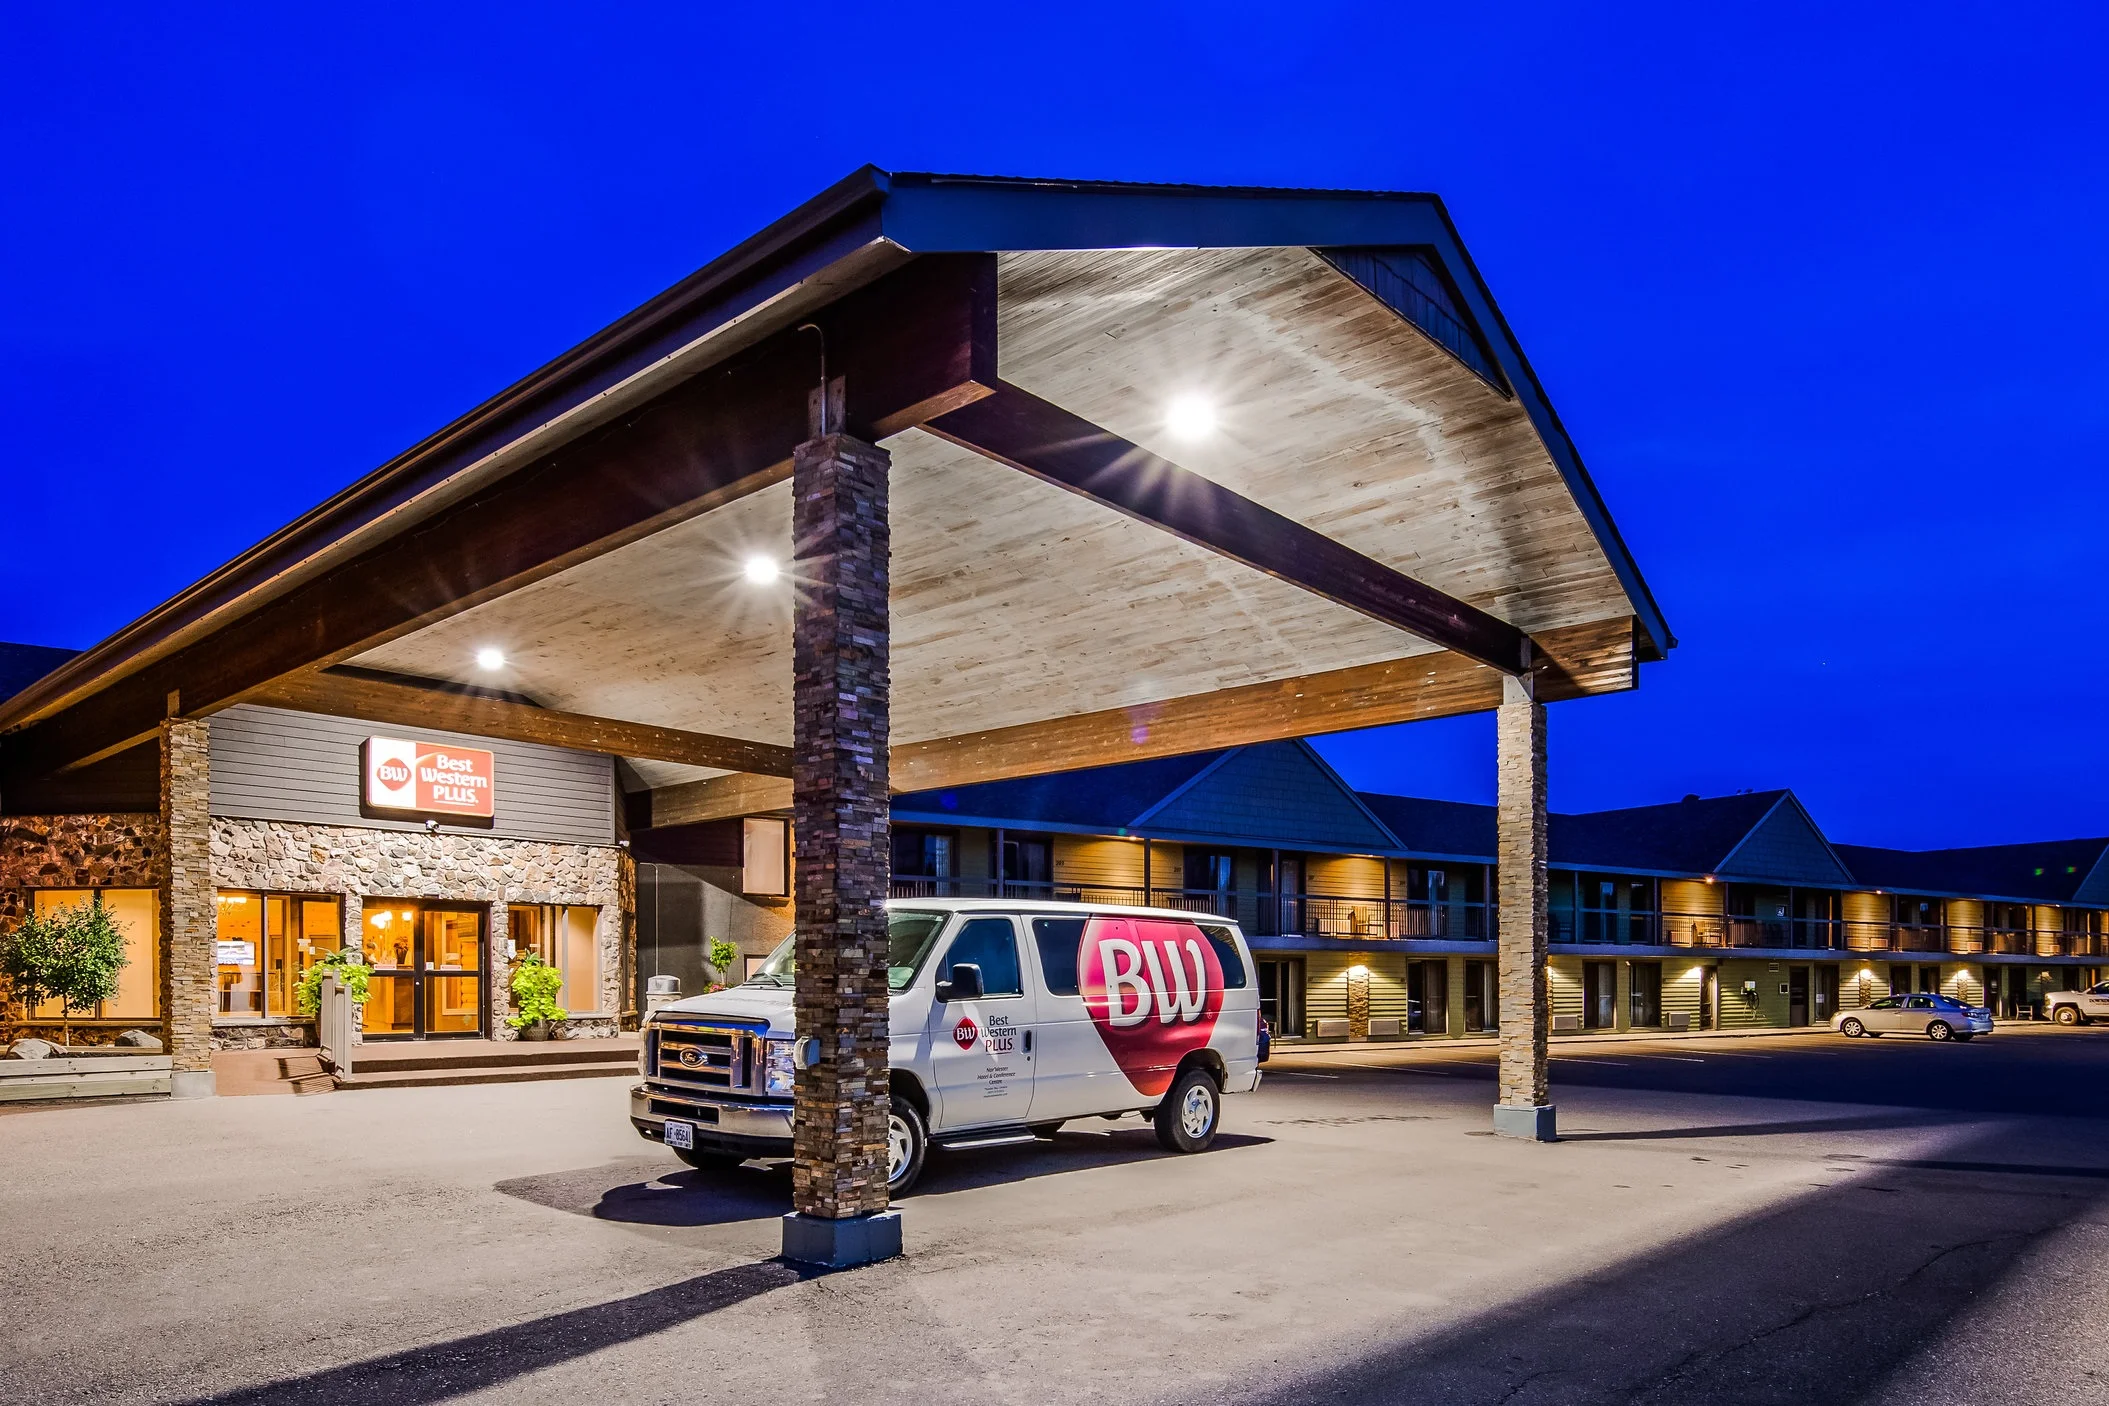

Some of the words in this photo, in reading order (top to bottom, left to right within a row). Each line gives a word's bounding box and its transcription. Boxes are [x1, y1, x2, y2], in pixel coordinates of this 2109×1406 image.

[436, 754, 473, 773] Best
[379, 765, 408, 782] BW
[420, 766, 488, 788] Western
[1098, 938, 1206, 1027] BW
[989, 1015, 1009, 1026] Best
[956, 1026, 976, 1040] BW
[980, 1026, 1017, 1038] Western
